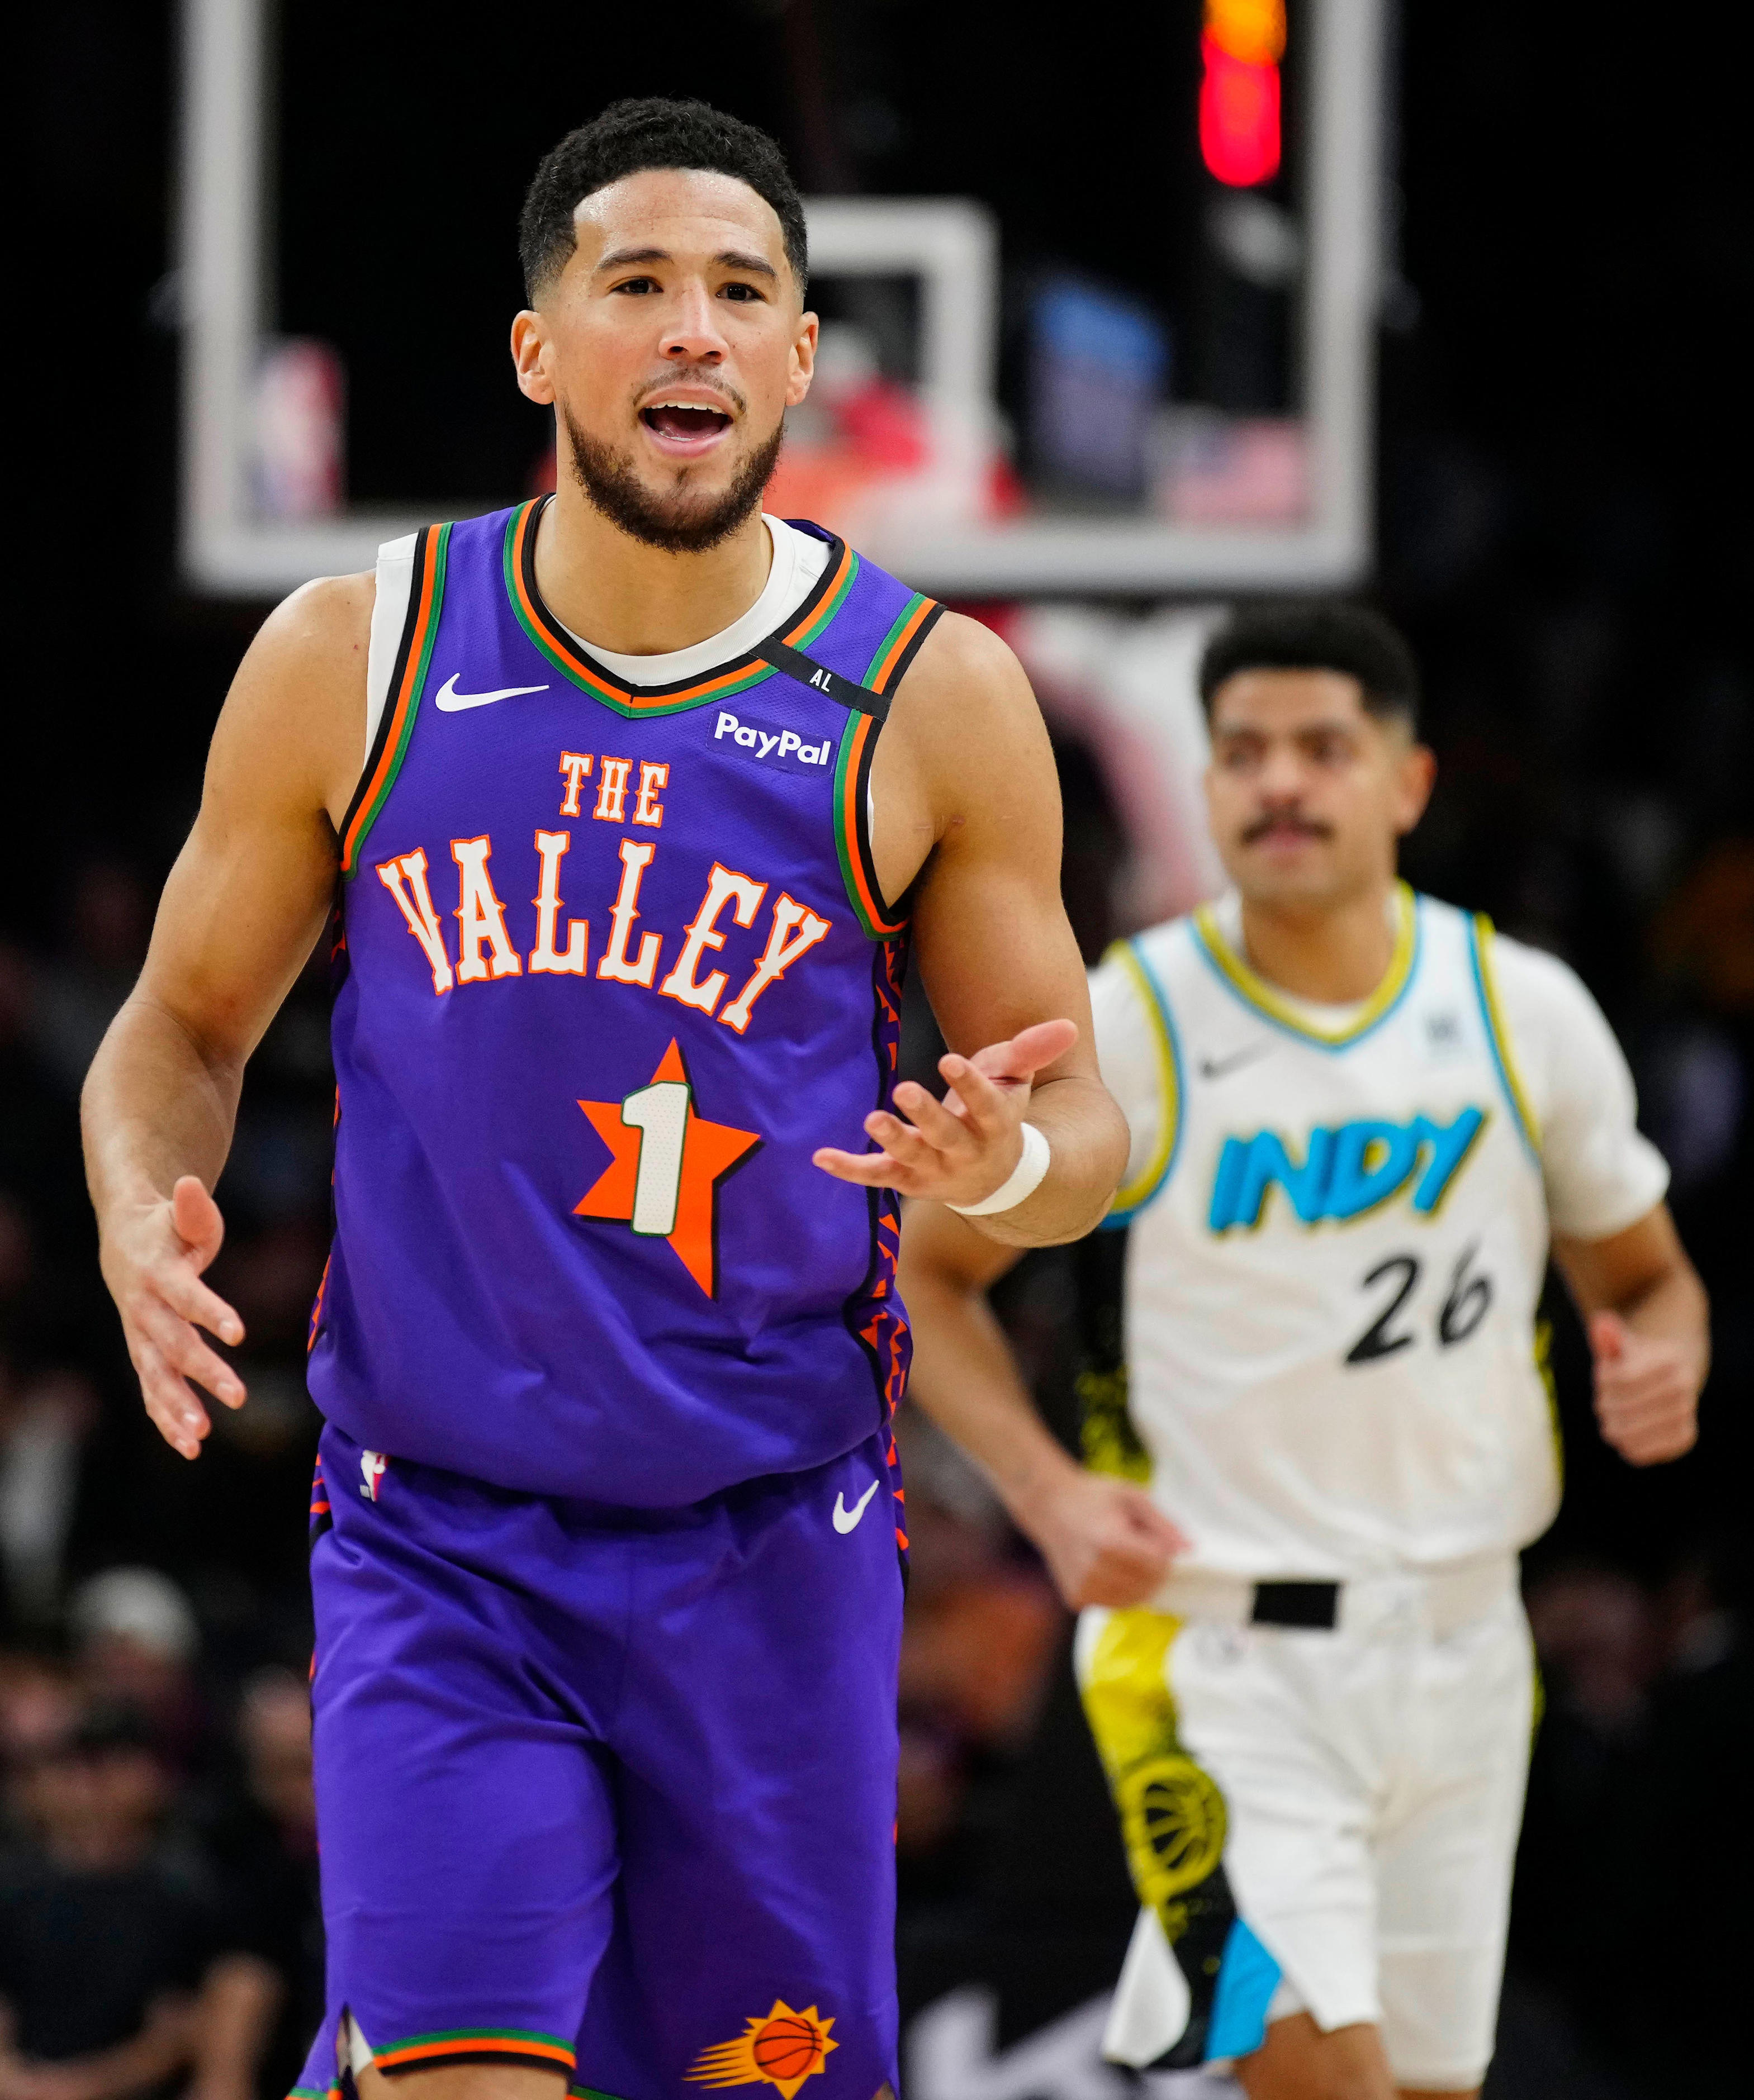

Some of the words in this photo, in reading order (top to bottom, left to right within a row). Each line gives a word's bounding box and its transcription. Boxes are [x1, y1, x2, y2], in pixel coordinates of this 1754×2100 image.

[714, 711, 831, 766] PayPal
[809, 668, 832, 692] AL
[559, 751, 669, 827] THE
[375, 830, 832, 1034] VALLEY
[621, 1080, 692, 1237] 1
[1206, 1105, 1488, 1237] INDY
[1344, 1236, 1494, 1366] 26
